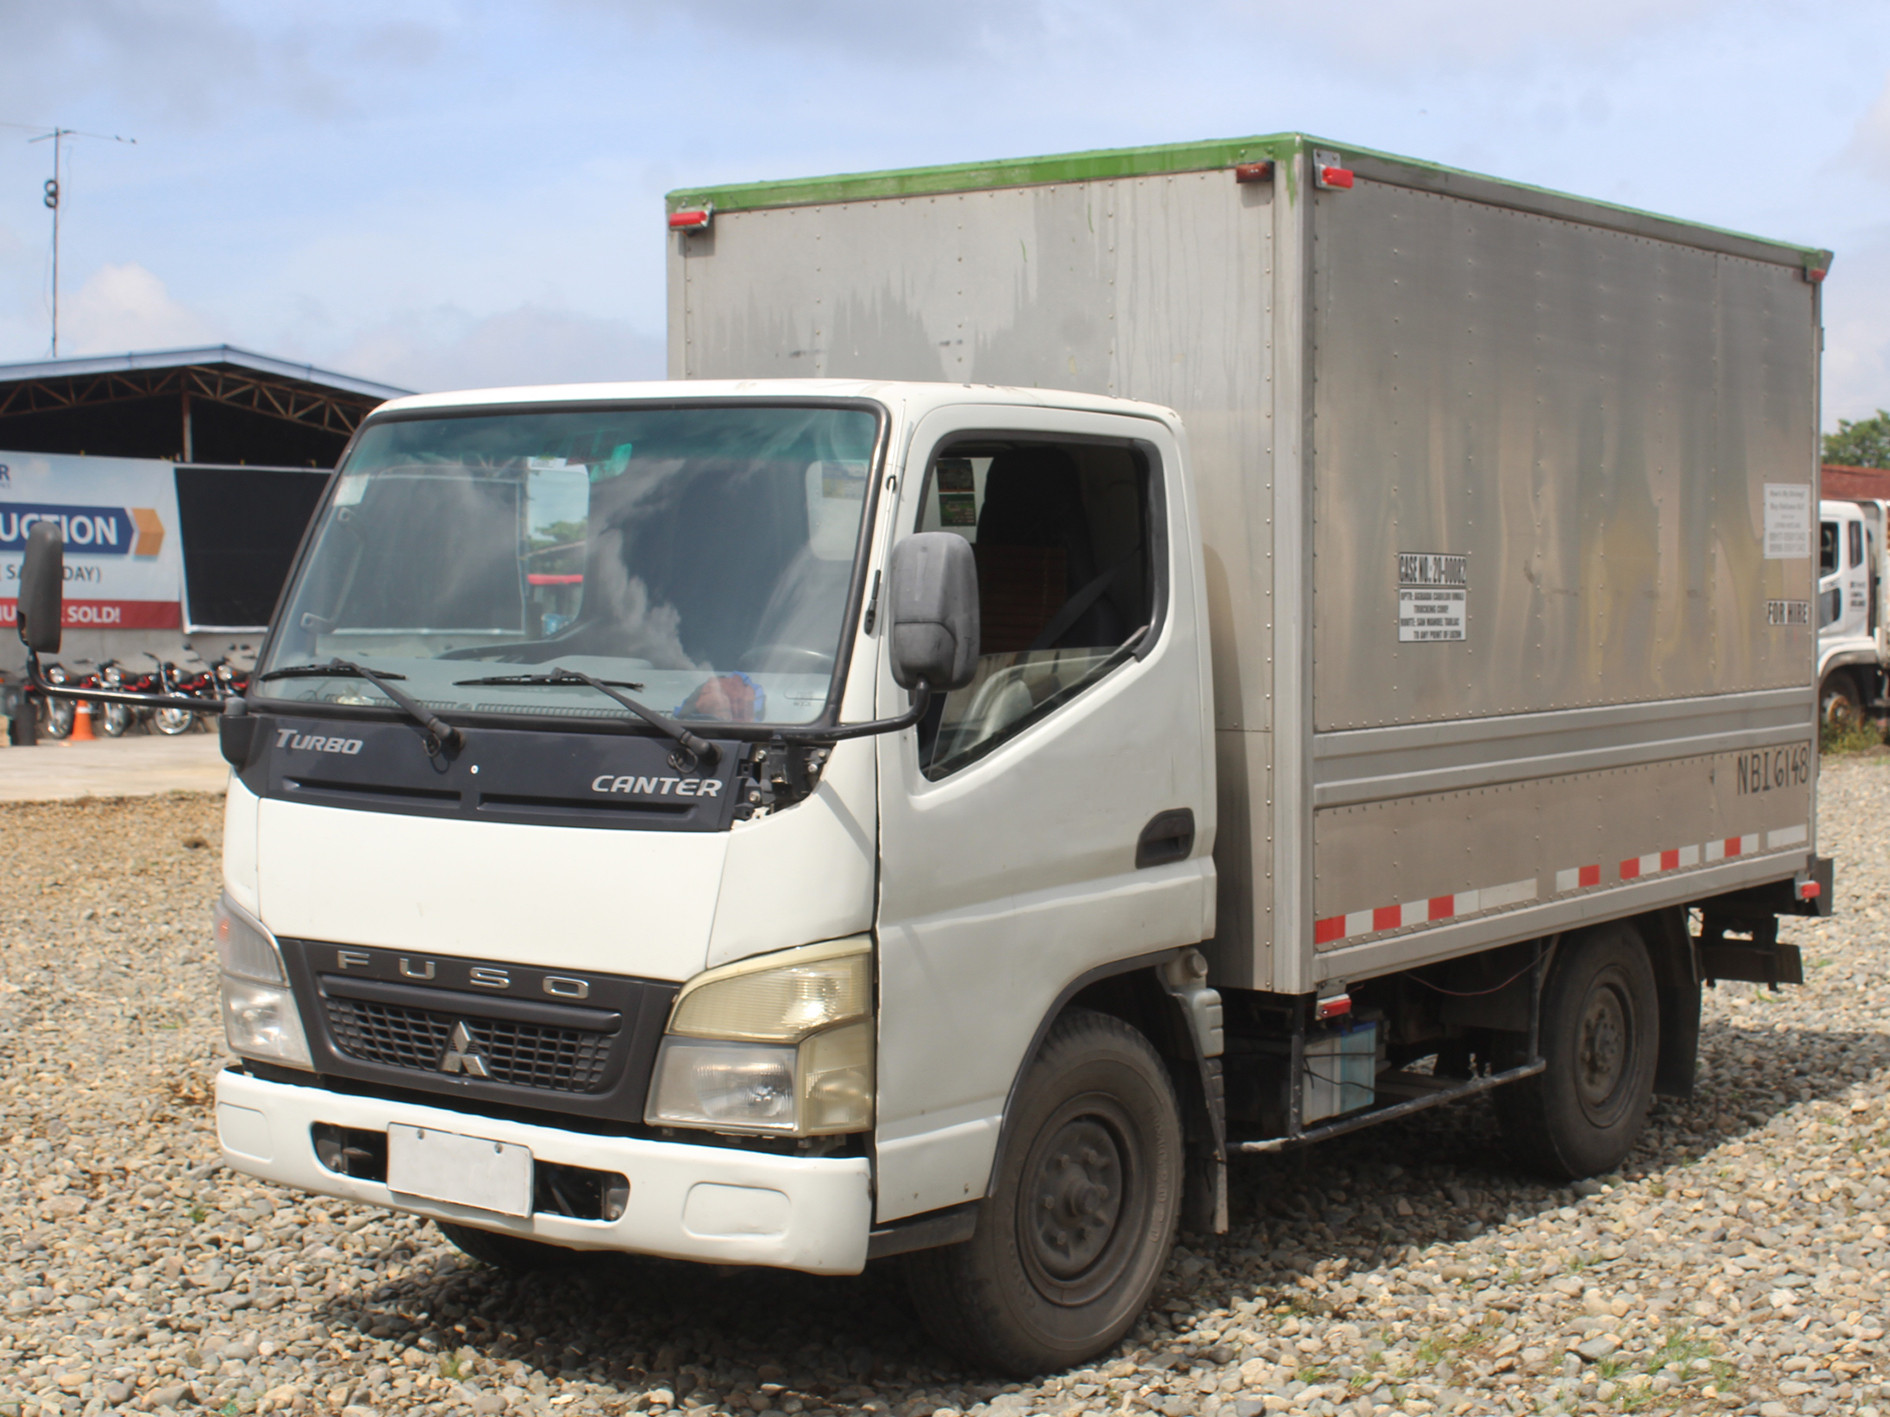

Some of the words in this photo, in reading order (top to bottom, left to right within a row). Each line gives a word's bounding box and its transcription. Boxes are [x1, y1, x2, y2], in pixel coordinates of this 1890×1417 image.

[67, 605, 120, 624] SOLD!
[592, 775, 723, 798] CANTER
[336, 950, 590, 1000] FUSO
